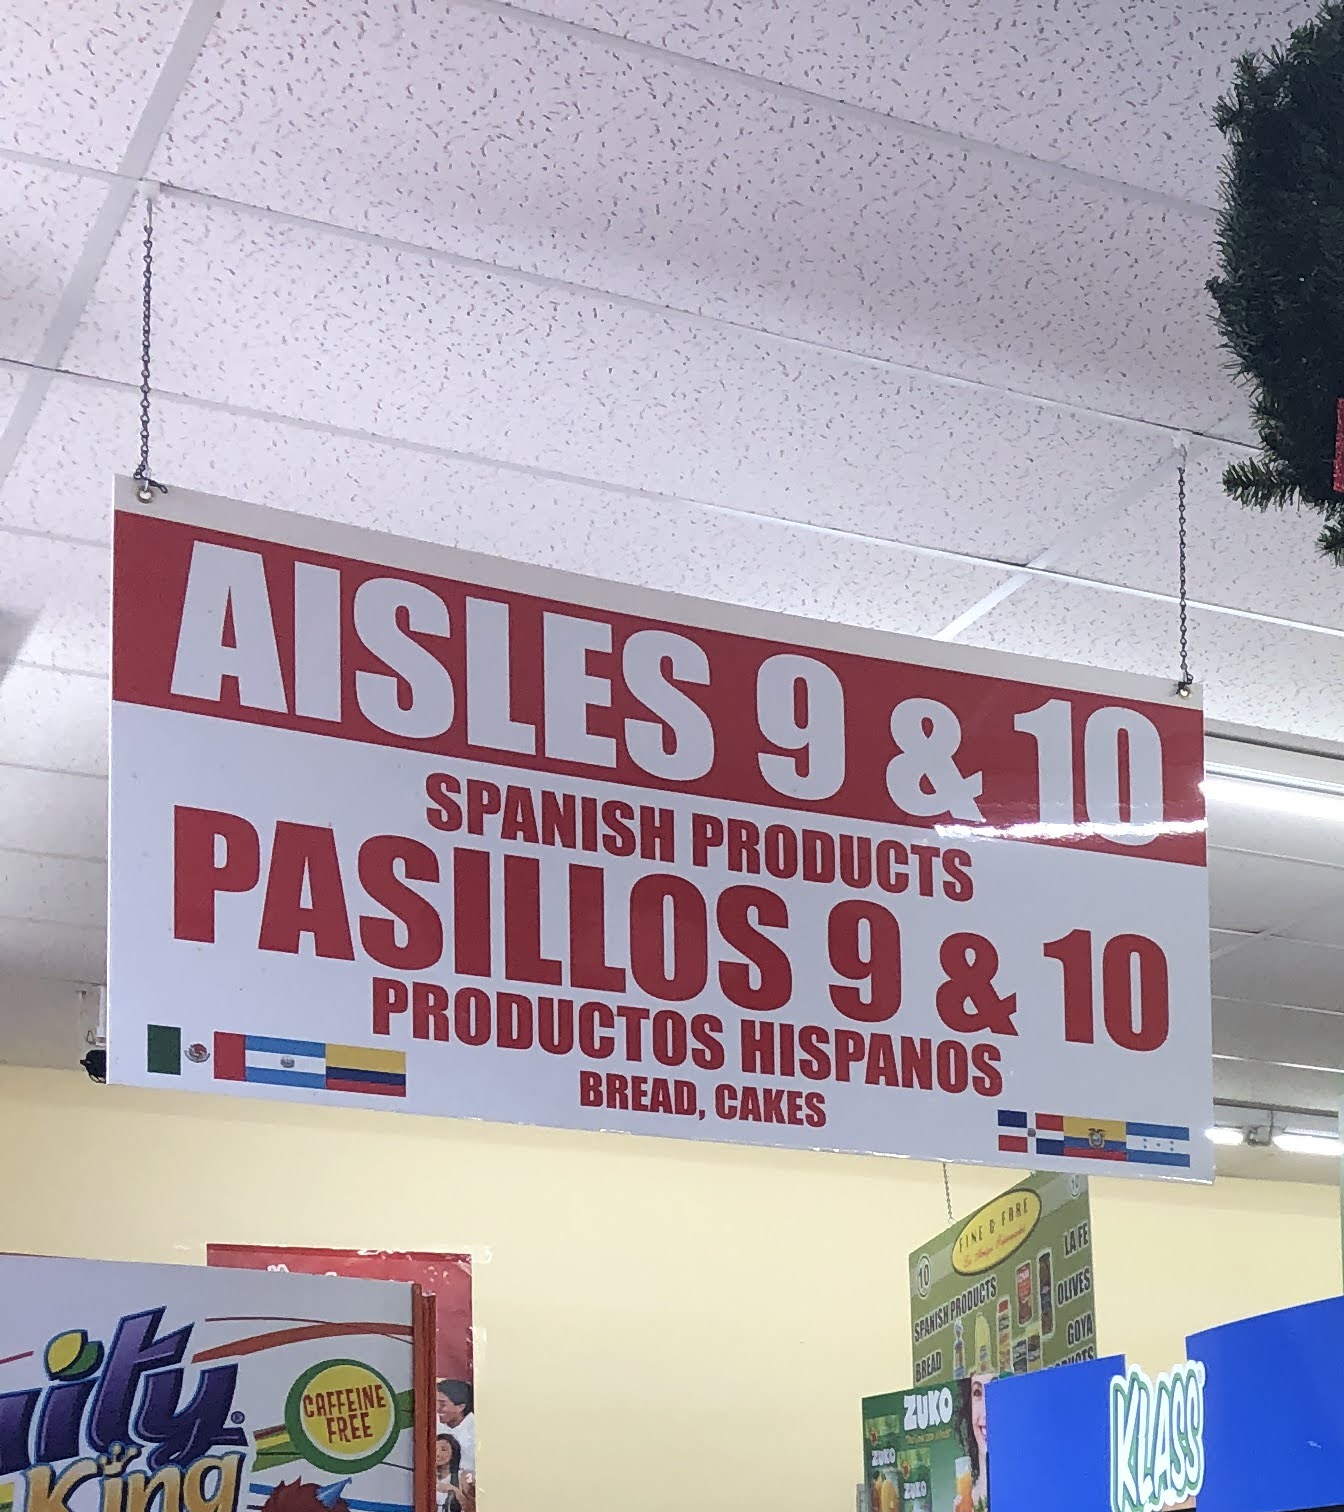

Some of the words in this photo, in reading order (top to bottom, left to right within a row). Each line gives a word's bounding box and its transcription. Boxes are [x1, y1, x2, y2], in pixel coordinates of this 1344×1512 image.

[171, 541, 713, 782] AISLES
[755, 653, 846, 802] 9
[886, 697, 984, 823] &
[1014, 699, 1163, 846] 10
[425, 772, 675, 863] SPANISH
[693, 811, 973, 902] PRODUCTS
[172, 804, 793, 1013] PASILLOS
[827, 900, 902, 1023] 9
[935, 931, 1017, 1037] &
[1044, 928, 1170, 1051] 10
[371, 976, 724, 1072] PRODUCTOS
[741, 1020, 1002, 1098] HISPANOS
[579, 1068, 706, 1122] BREAD,
[715, 1083, 827, 1128] CAKES
[959, 1226, 982, 1252] FINE
[1001, 1197, 1028, 1226] FARE
[1065, 1230, 1076, 1256] LA
[1078, 1223, 1088, 1247] FE
[919, 1265, 929, 1286] 10
[1057, 1267, 1090, 1305] OLIVES
[914, 1304, 949, 1342] SPANISH
[950, 1276, 997, 1320] PRODUCTS
[1067, 1314, 1093, 1345] GOYA
[915, 1352, 942, 1382] BREAD
[303, 1384, 387, 1419] CAFFEINE
[904, 1387, 953, 1431] ZUKO
[326, 1412, 374, 1443] FREE
